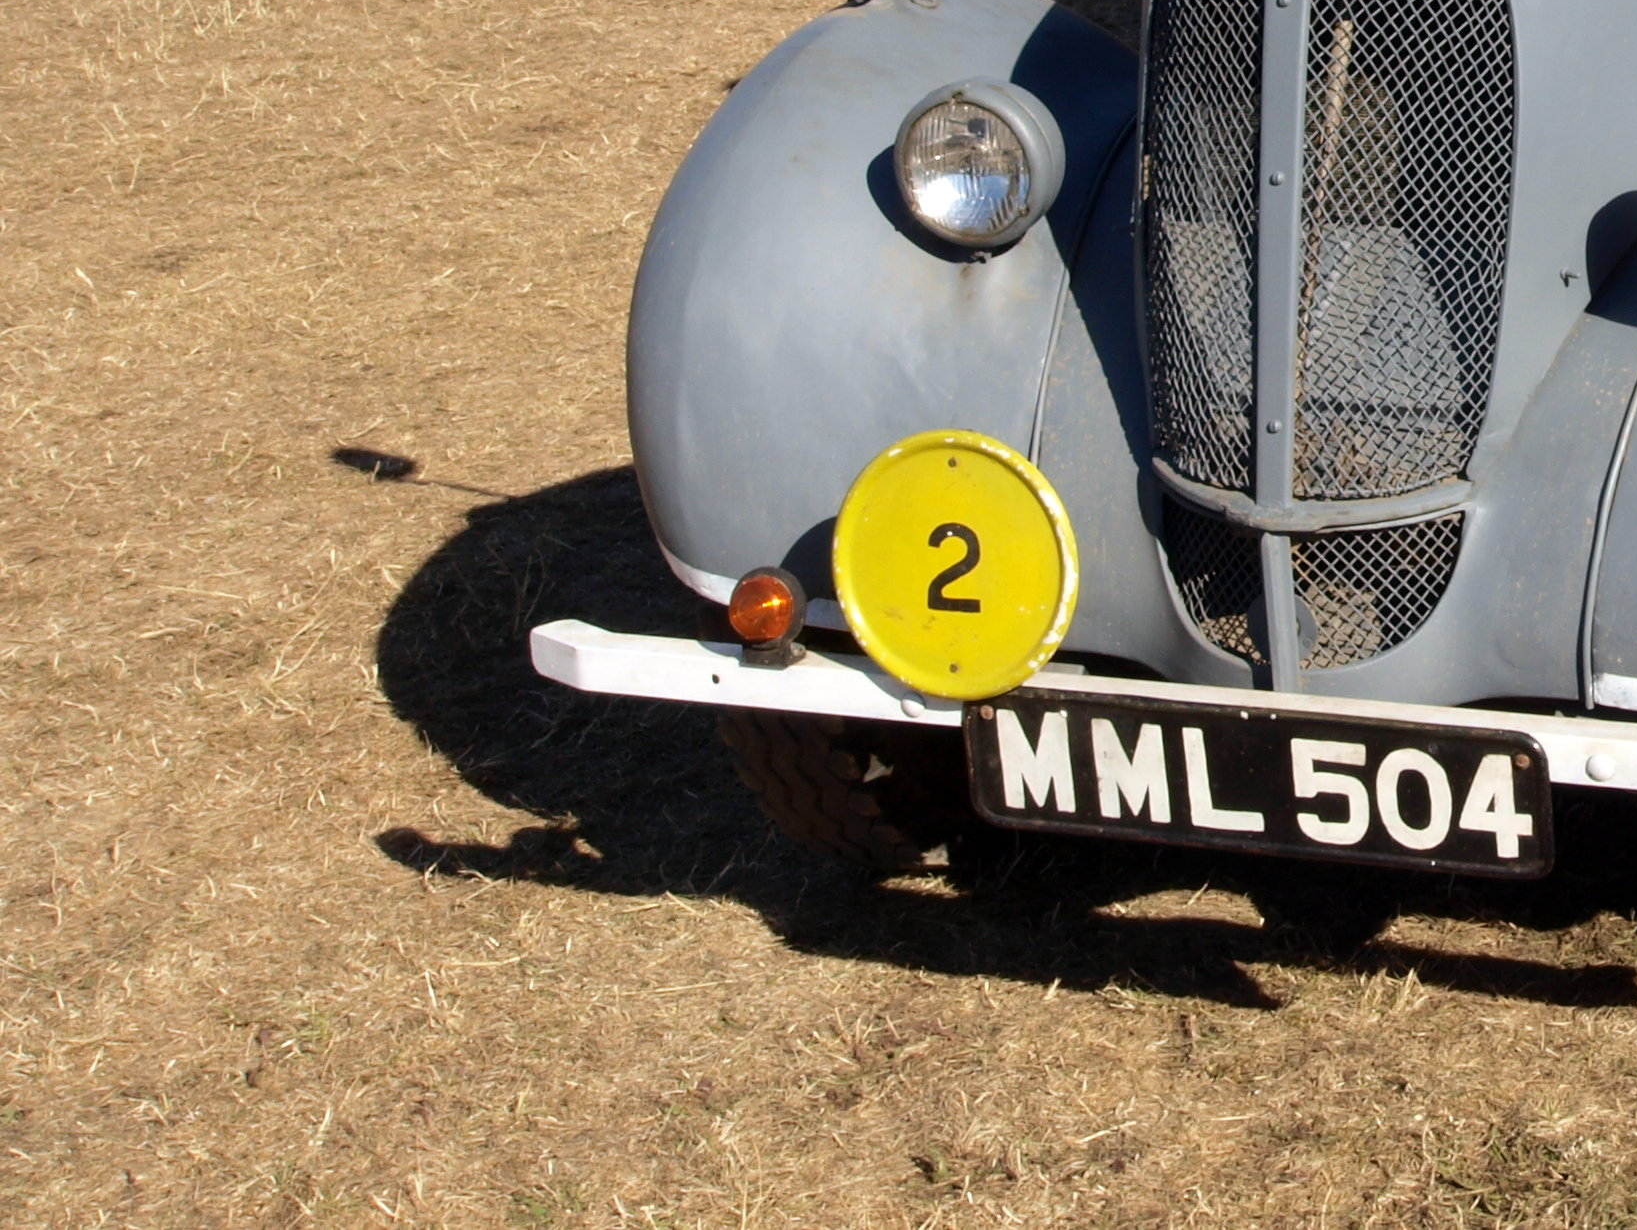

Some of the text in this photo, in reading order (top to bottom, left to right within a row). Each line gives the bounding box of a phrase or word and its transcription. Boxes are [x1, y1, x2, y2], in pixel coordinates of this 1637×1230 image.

[928, 523, 981, 613] 2
[996, 708, 1533, 858] MML 504
